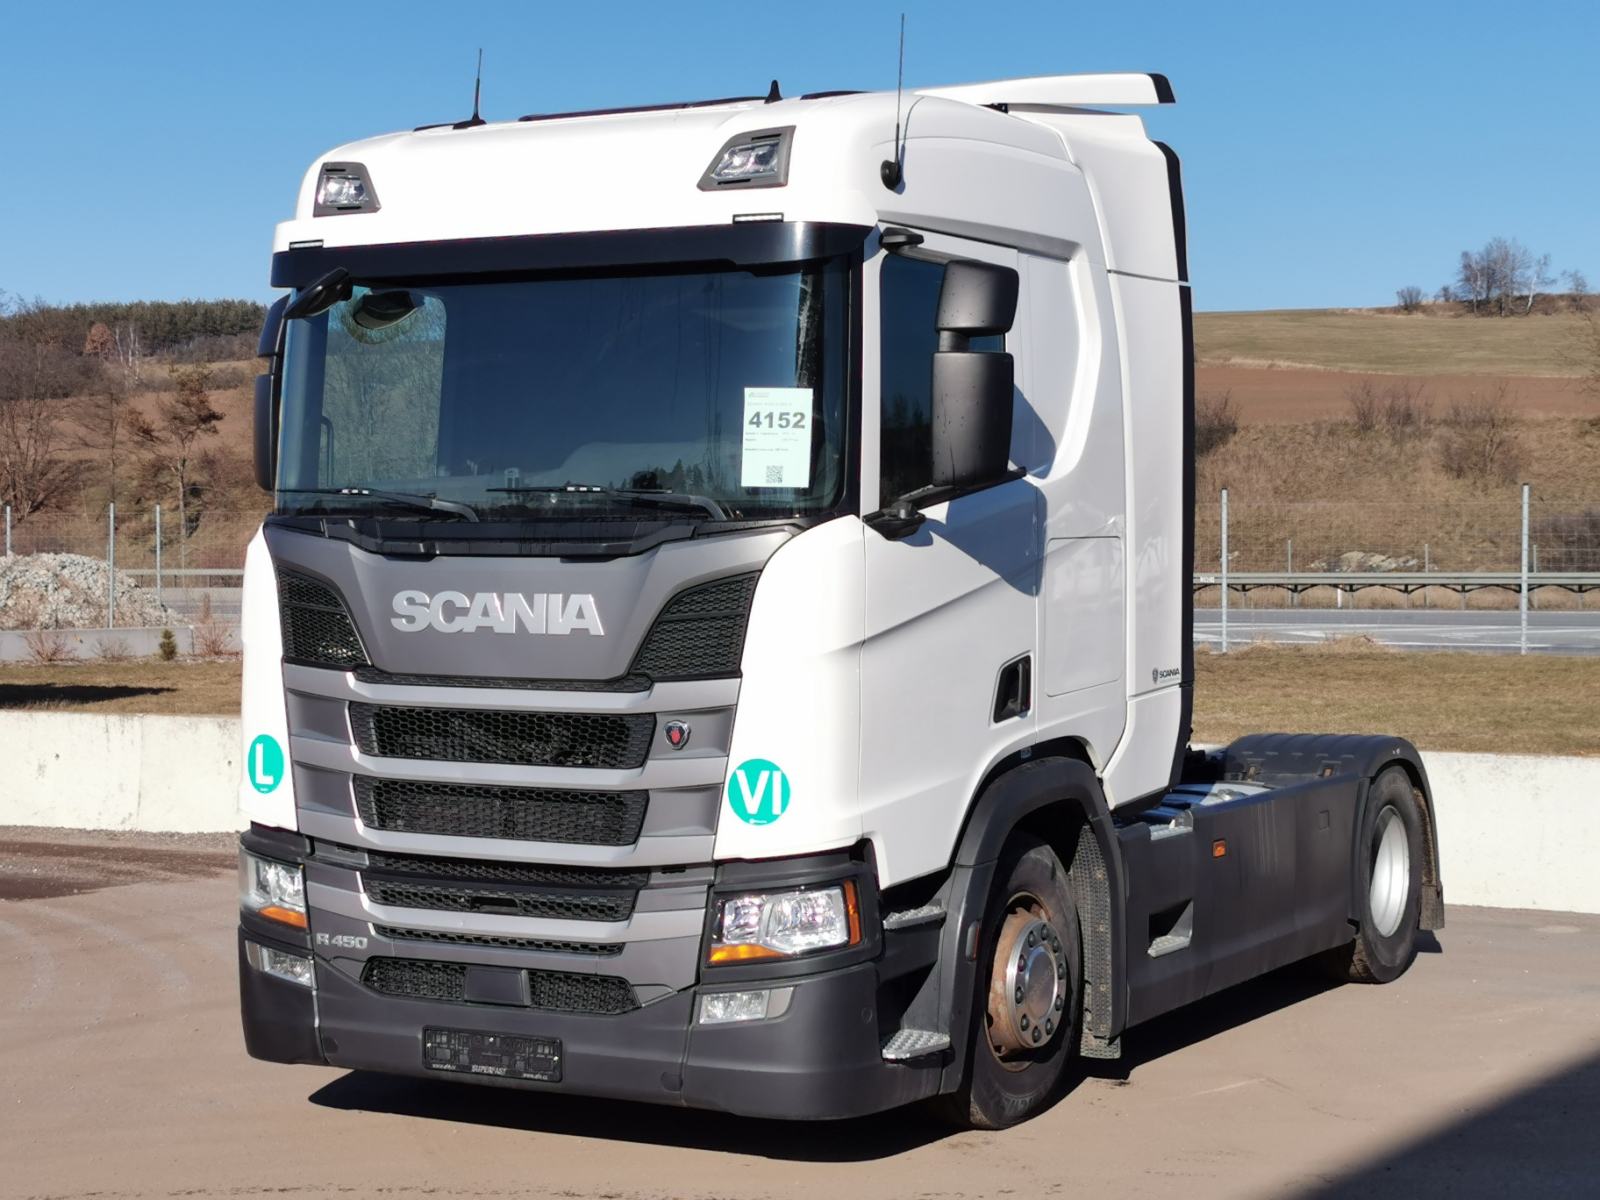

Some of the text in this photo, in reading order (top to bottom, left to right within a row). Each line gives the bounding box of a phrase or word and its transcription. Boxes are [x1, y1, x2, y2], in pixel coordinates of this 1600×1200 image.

[748, 411, 806, 429] 4152
[390, 590, 605, 636] SCANIA
[1158, 667, 1181, 679] SCANIA
[255, 742, 275, 785] L
[735, 769, 783, 816] VI
[316, 932, 368, 949] R 450
